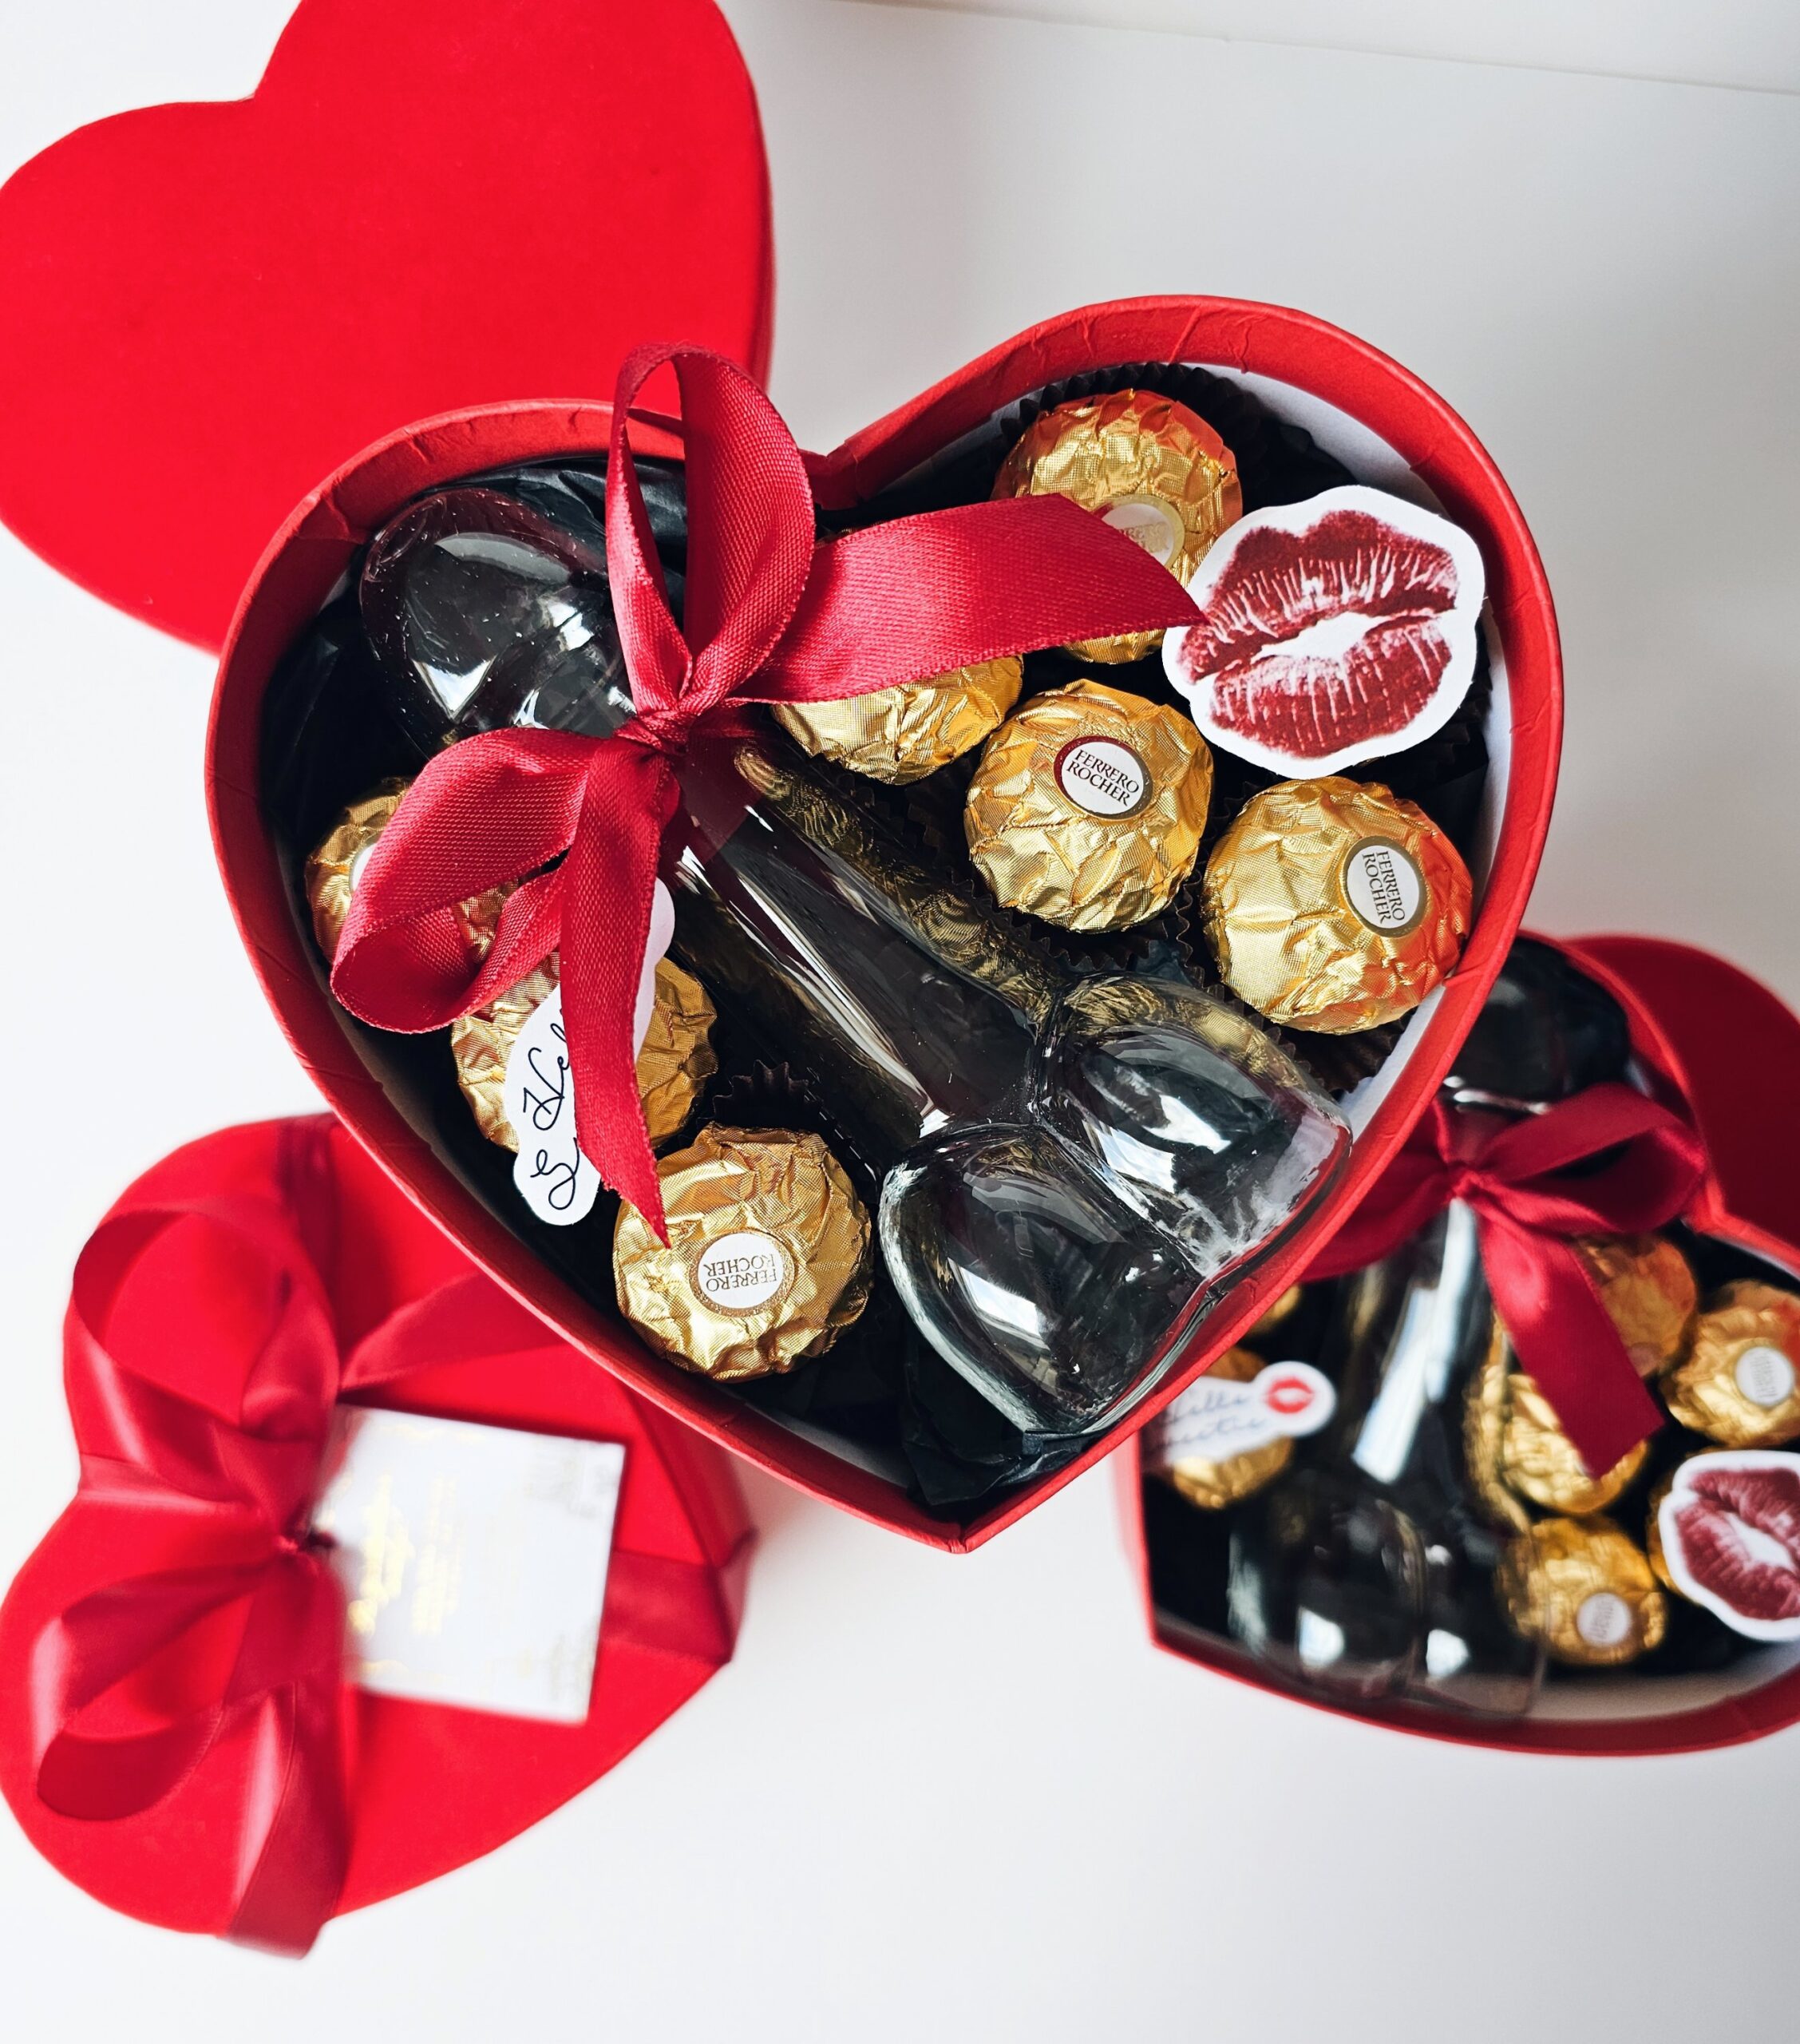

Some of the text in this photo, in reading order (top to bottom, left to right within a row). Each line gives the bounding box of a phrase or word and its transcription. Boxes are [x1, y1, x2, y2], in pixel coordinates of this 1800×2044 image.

[1066, 761, 1130, 806] ROCHER
[1074, 749, 1139, 794] FERRERO
[1362, 853, 1391, 924] ROCHER
[1376, 850, 1406, 921] FERRERO
[703, 1254, 775, 1277] ROCHER
[706, 1269, 777, 1292] FERRERO
